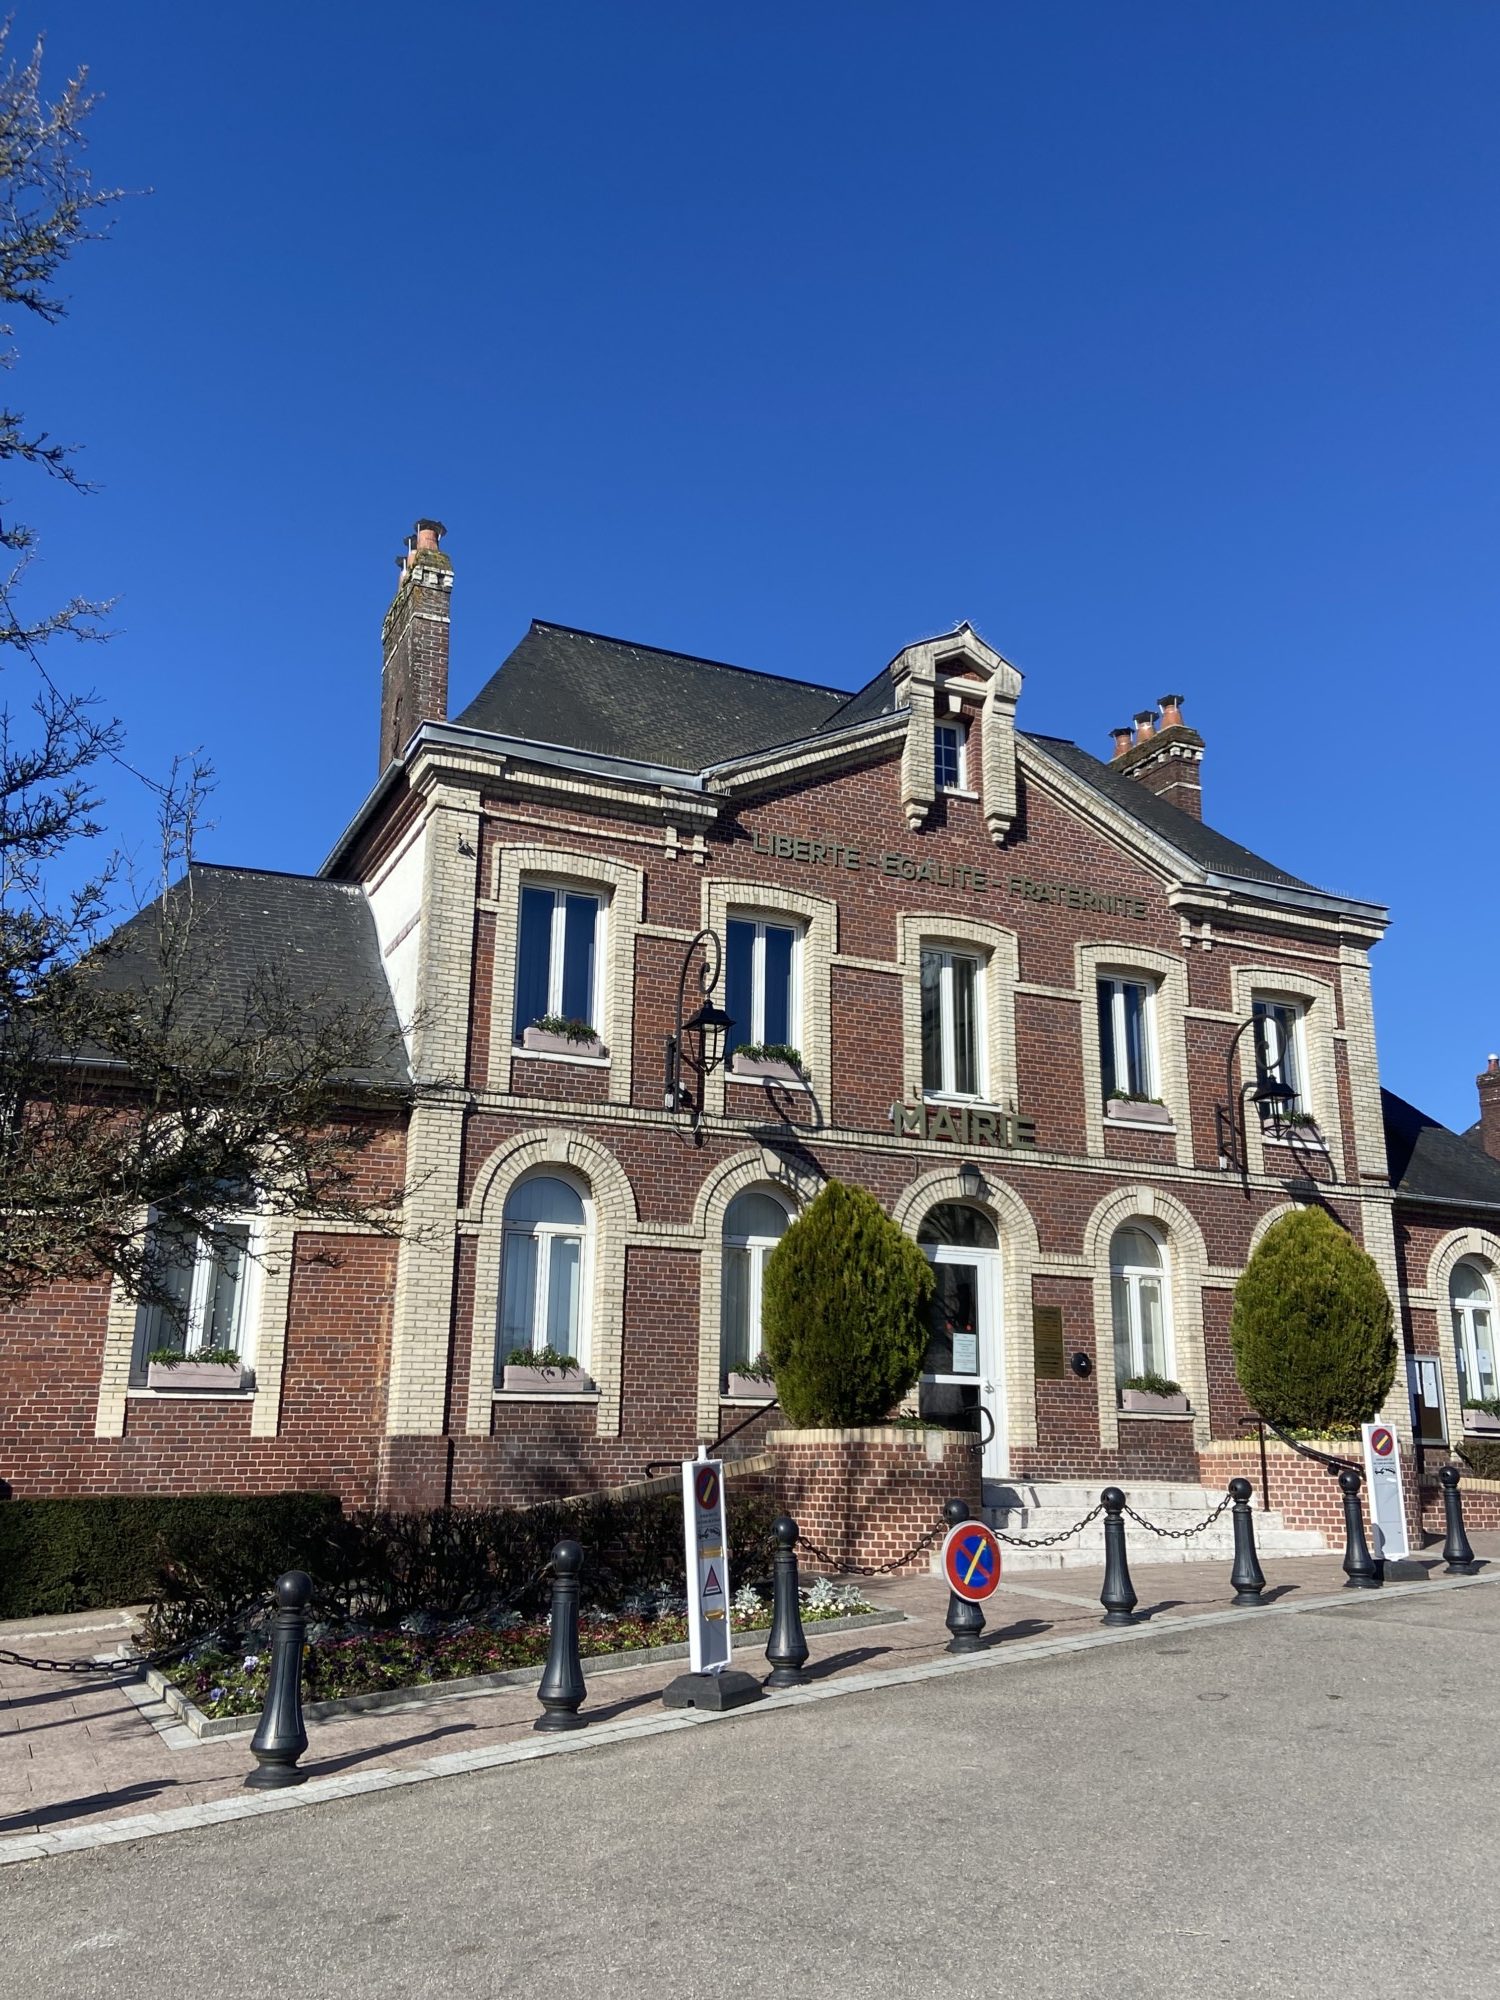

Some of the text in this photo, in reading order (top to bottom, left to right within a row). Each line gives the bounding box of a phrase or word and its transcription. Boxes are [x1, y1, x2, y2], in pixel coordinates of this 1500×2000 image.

[752, 830, 860, 870] LIBERTE
[881, 852, 987, 892] EGALITE
[1007, 875, 1148, 920] FRATERNITE
[893, 1102, 1036, 1150] MAIRIE
